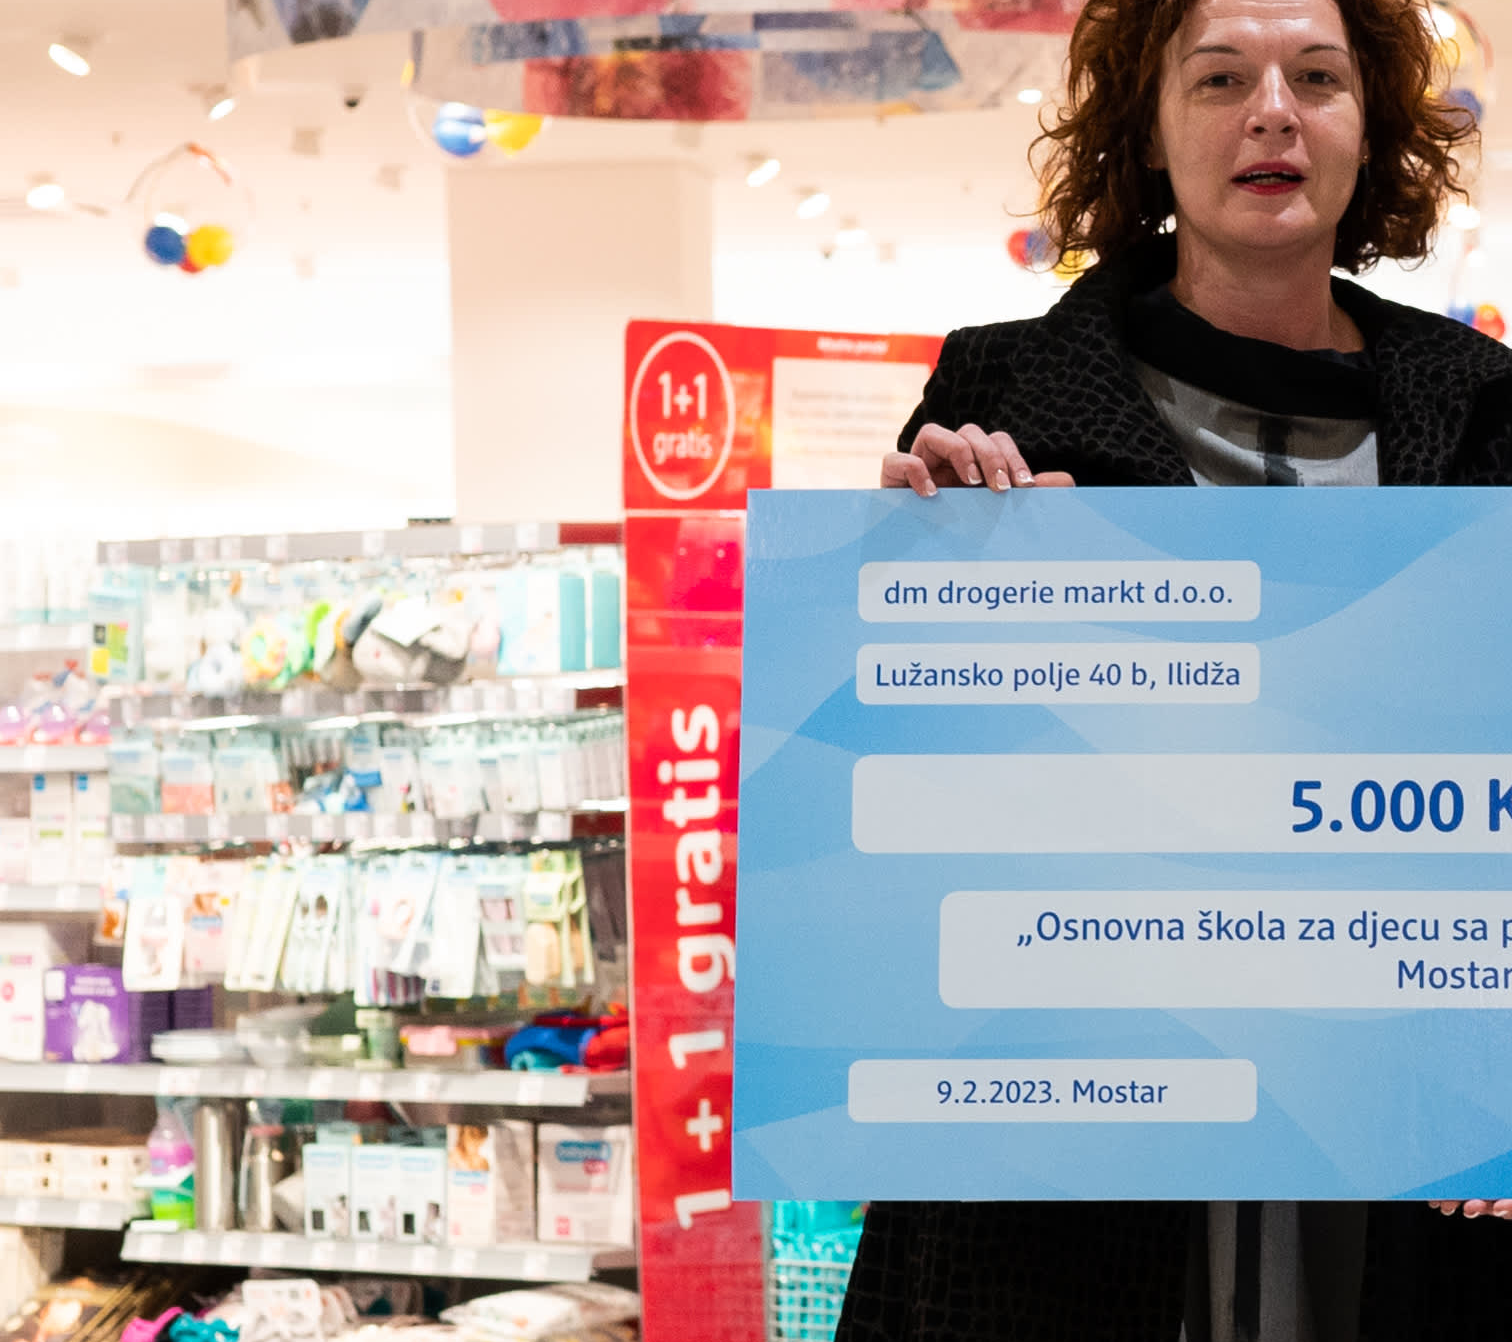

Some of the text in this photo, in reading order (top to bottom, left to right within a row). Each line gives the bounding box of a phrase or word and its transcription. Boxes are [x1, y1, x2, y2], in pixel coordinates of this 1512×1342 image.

[658, 371, 707, 420] 1+1
[652, 431, 714, 466] gratis
[883, 579, 1233, 611] dm drogerie markt d.o.o.
[875, 661, 1241, 693] Lužansko polje 40 b, Ilidža
[1291, 779, 1465, 834] 5.000
[658, 704, 735, 993] gratis
[1016, 910, 1185, 947] „Osnovna
[1197, 909, 1286, 942] škola
[1297, 917, 1336, 942] za
[1347, 909, 1440, 949] djecu
[1452, 918, 1489, 942] sa
[936, 1079, 1169, 1105] 9.2.2023. Mostar
